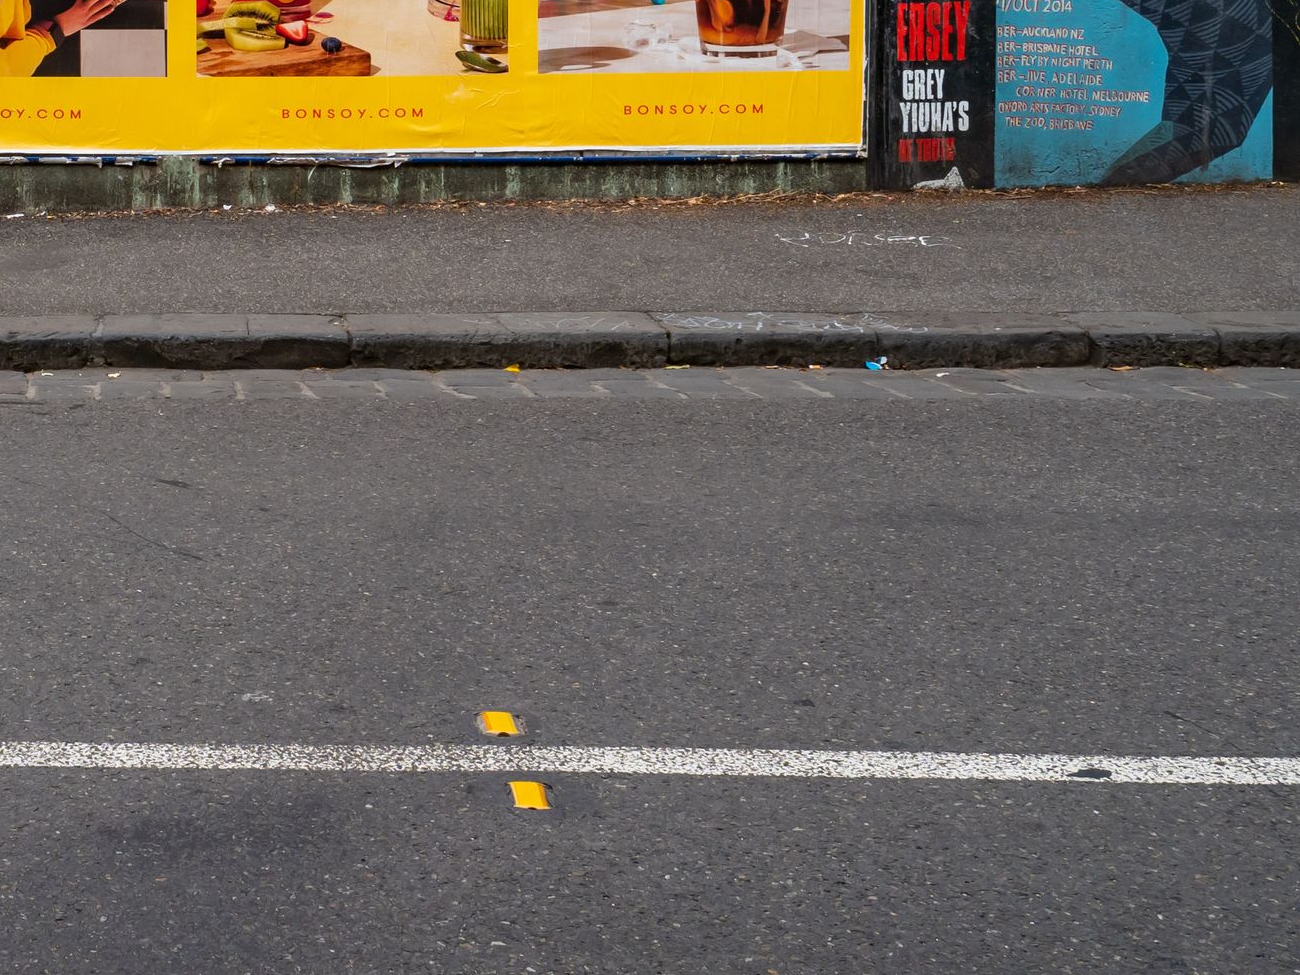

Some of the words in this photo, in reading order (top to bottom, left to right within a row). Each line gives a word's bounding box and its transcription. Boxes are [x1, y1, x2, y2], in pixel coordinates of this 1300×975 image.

[1070, 29, 1085, 40] NZ
[1069, 45, 1099, 56] HOTEL
[1037, 56, 1049, 67] BY
[1052, 57, 1081, 67] NIGHT
[1083, 59, 1113, 70] PERTH
[902, 68, 945, 101] GREY
[1052, 72, 1103, 86] ADELAIDE
[1016, 86, 1056, 97] CORNER
[1092, 90, 1150, 103] MELBOURNE
[282, 107, 425, 119] BONSOY.COM
[623, 103, 765, 116] BONSOY.COM
[1029, 102, 1049, 114] ARTS
[1089, 105, 1122, 117] SYDNEY
[1005, 116, 1022, 127] THE
[1049, 119, 1093, 130] BRISBANE
